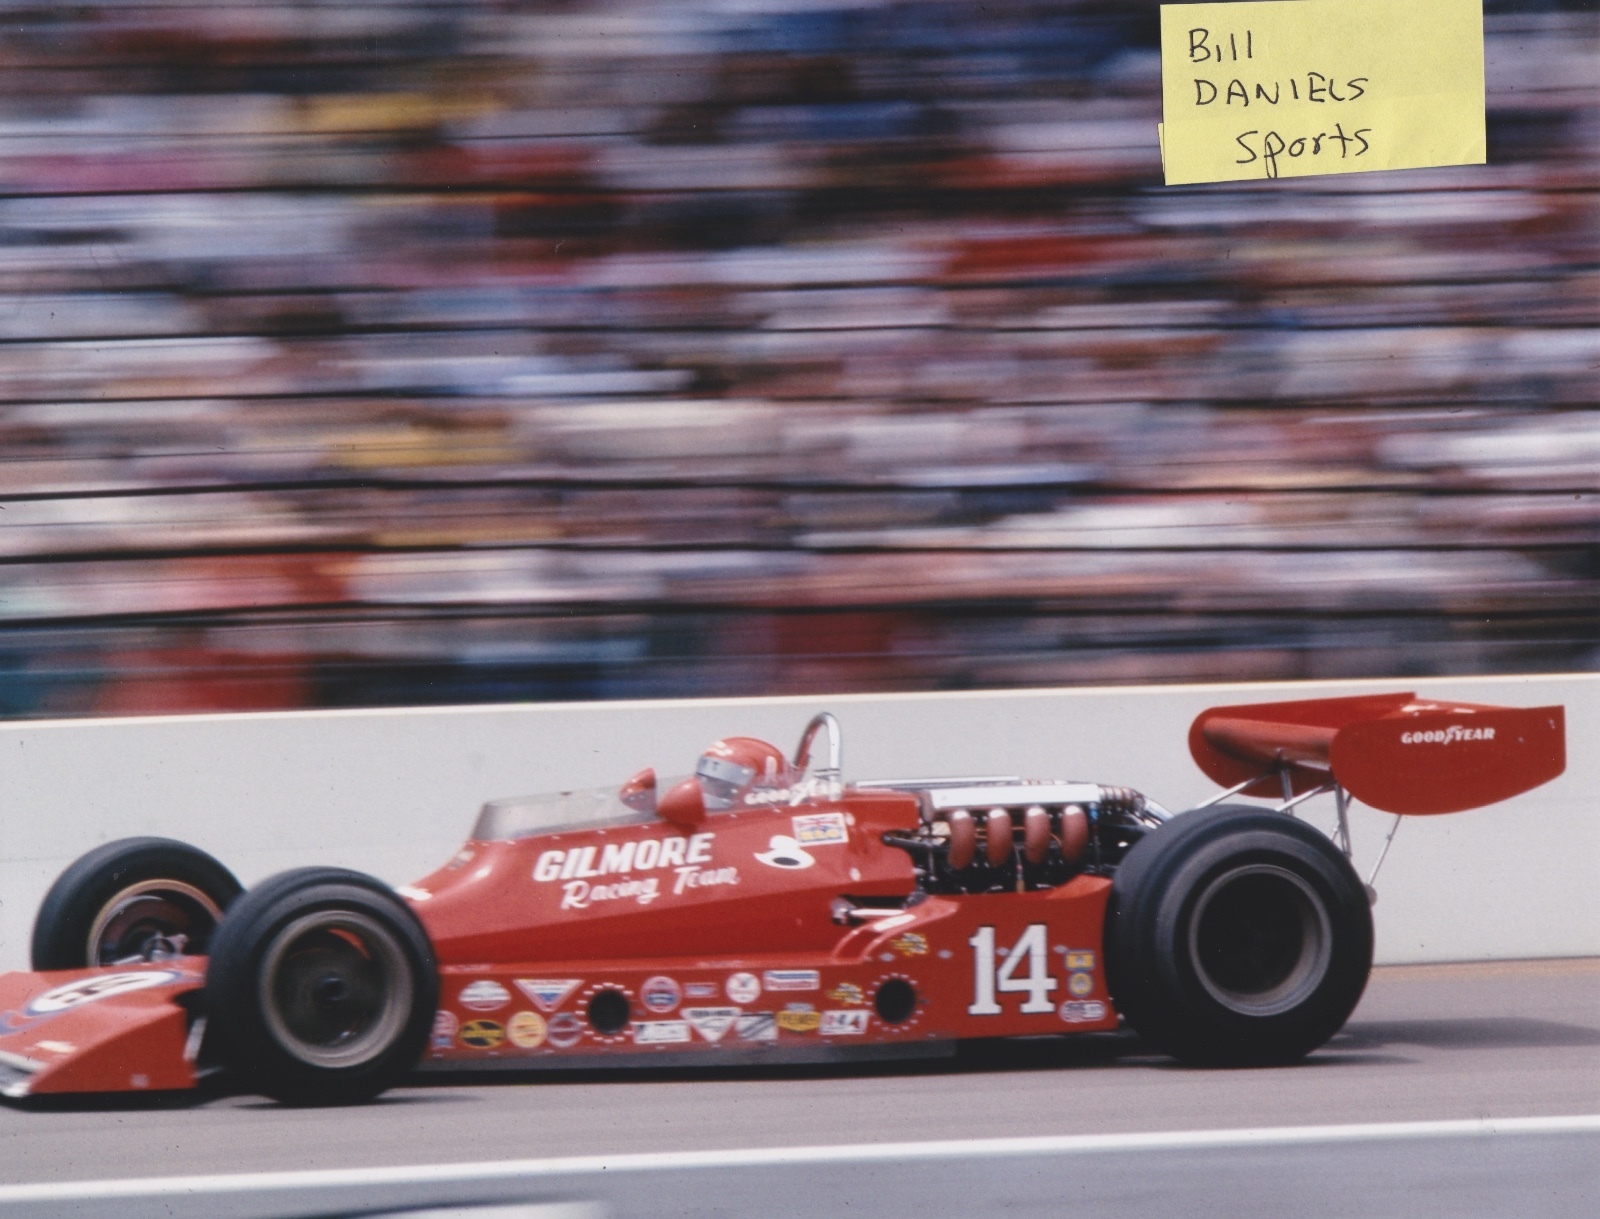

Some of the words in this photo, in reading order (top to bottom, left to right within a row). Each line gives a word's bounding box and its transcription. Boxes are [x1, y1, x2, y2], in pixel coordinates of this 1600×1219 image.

[1188, 27, 1253, 62] Bill
[1193, 71, 1369, 107] DANIELS
[1400, 725, 1496, 745] GOODYEAR
[532, 832, 716, 882] GILMORE
[560, 877, 660, 910] Racing
[673, 865, 741, 895] Team
[968, 924, 1057, 1015] 14
